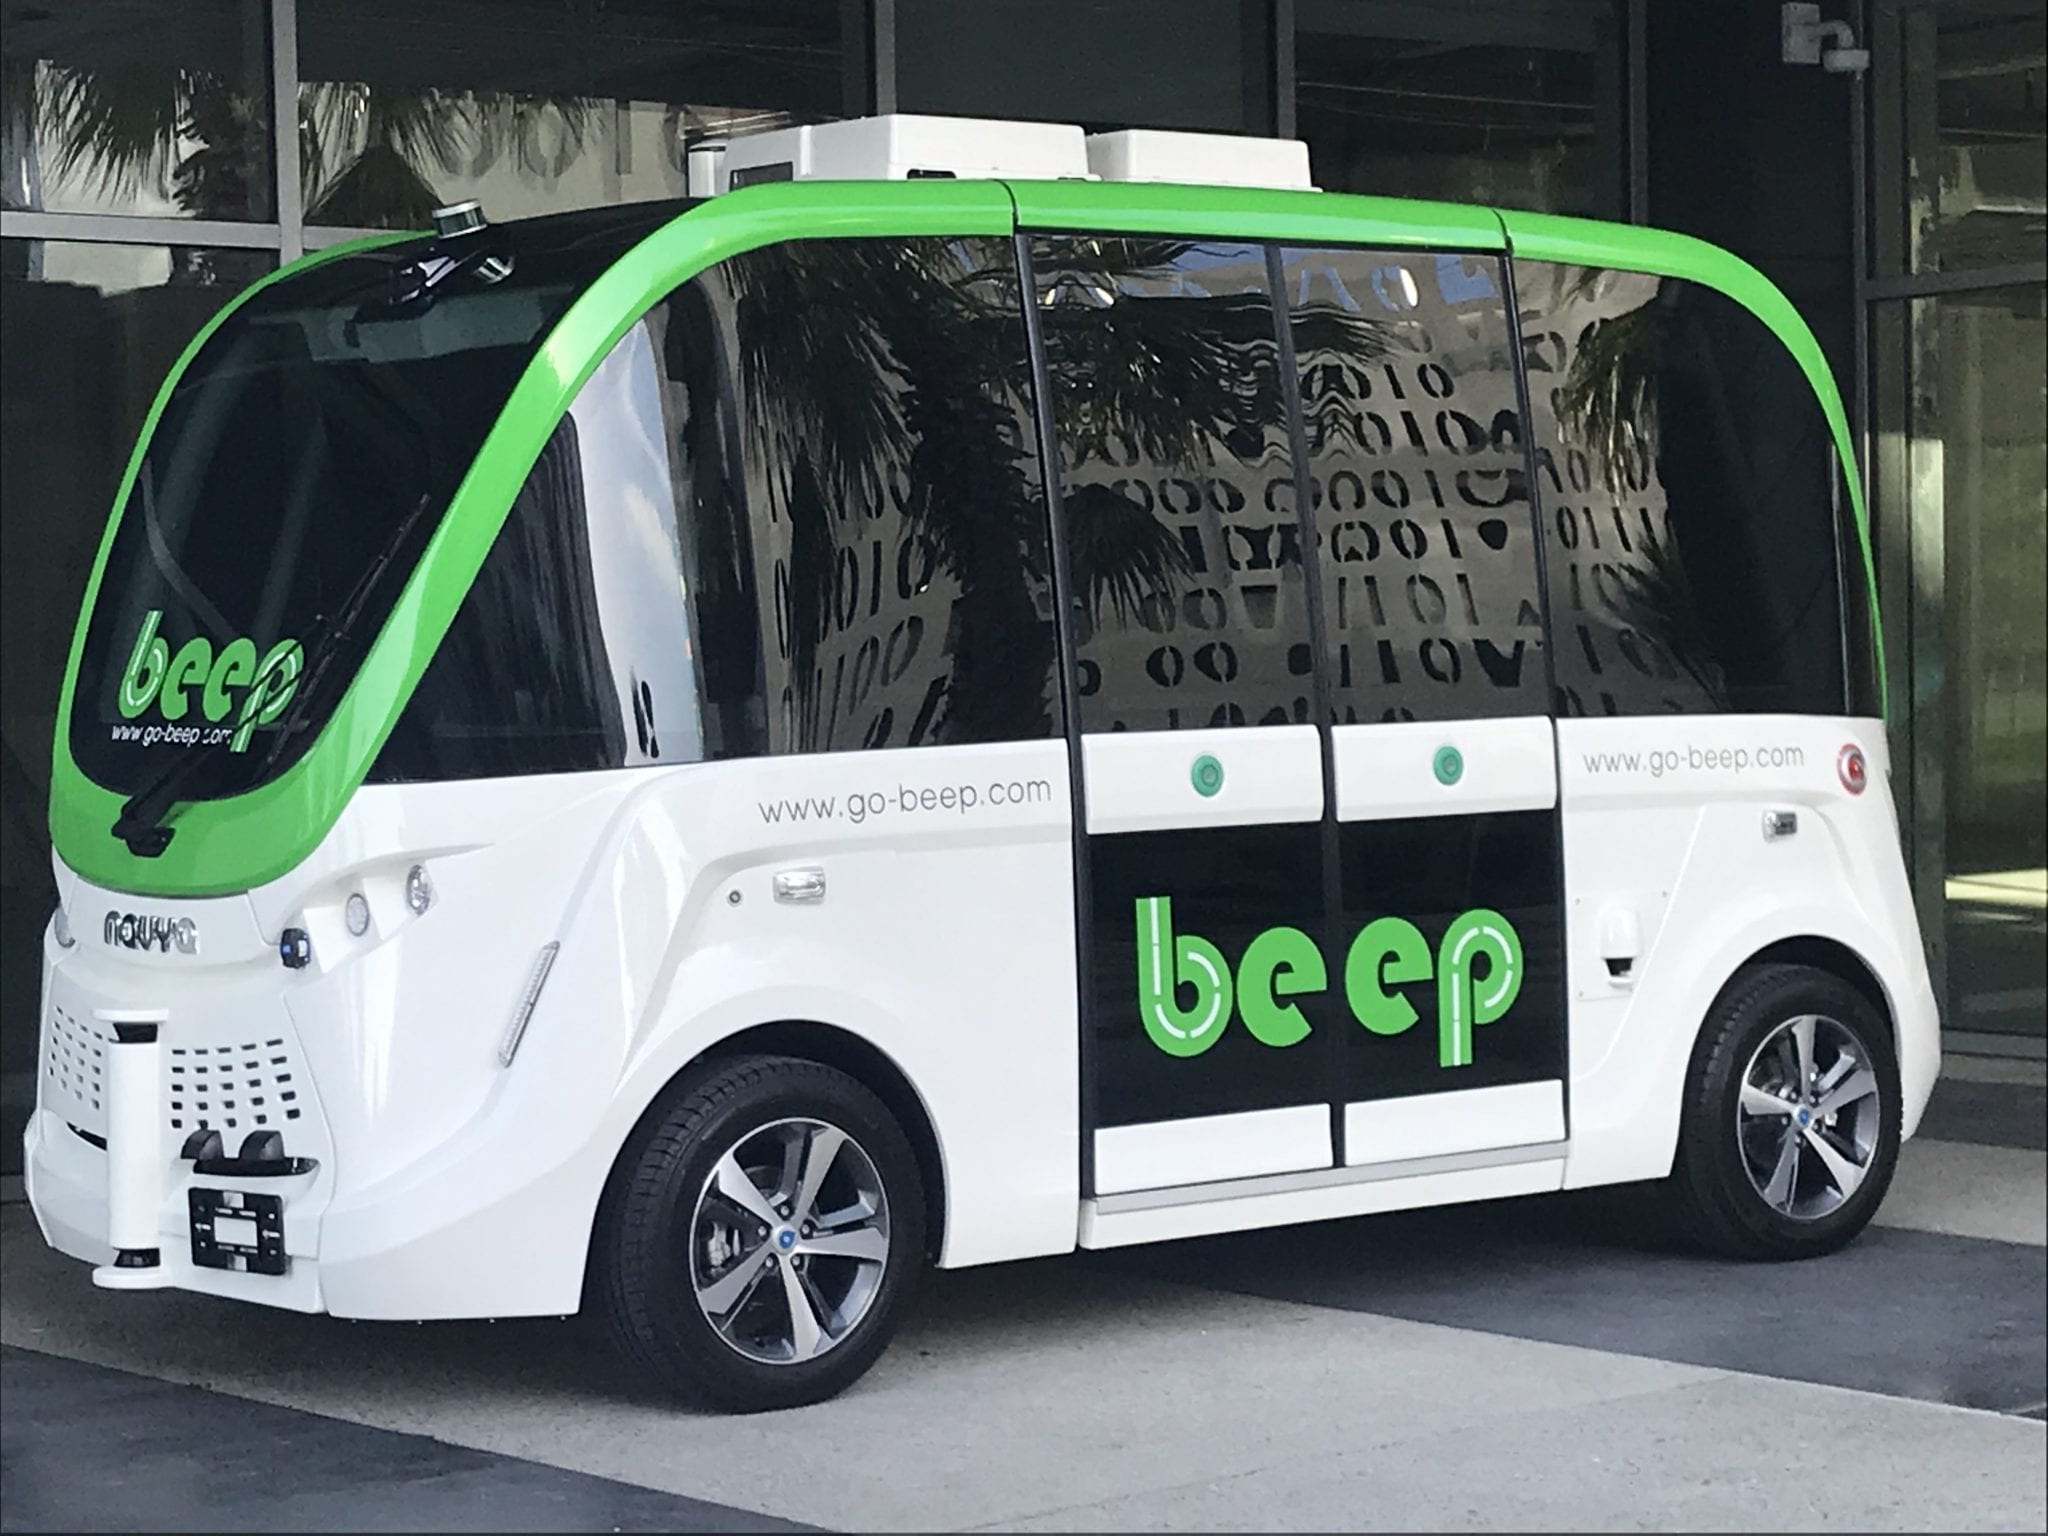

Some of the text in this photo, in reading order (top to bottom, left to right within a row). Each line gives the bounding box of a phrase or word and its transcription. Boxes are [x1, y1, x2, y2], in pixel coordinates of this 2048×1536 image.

[118, 610, 304, 753] beep
[111, 723, 232, 748] wwwgo-beepcom
[1583, 745, 1804, 778] www.go-beep.com
[758, 779, 1051, 824] www.go-beep.com
